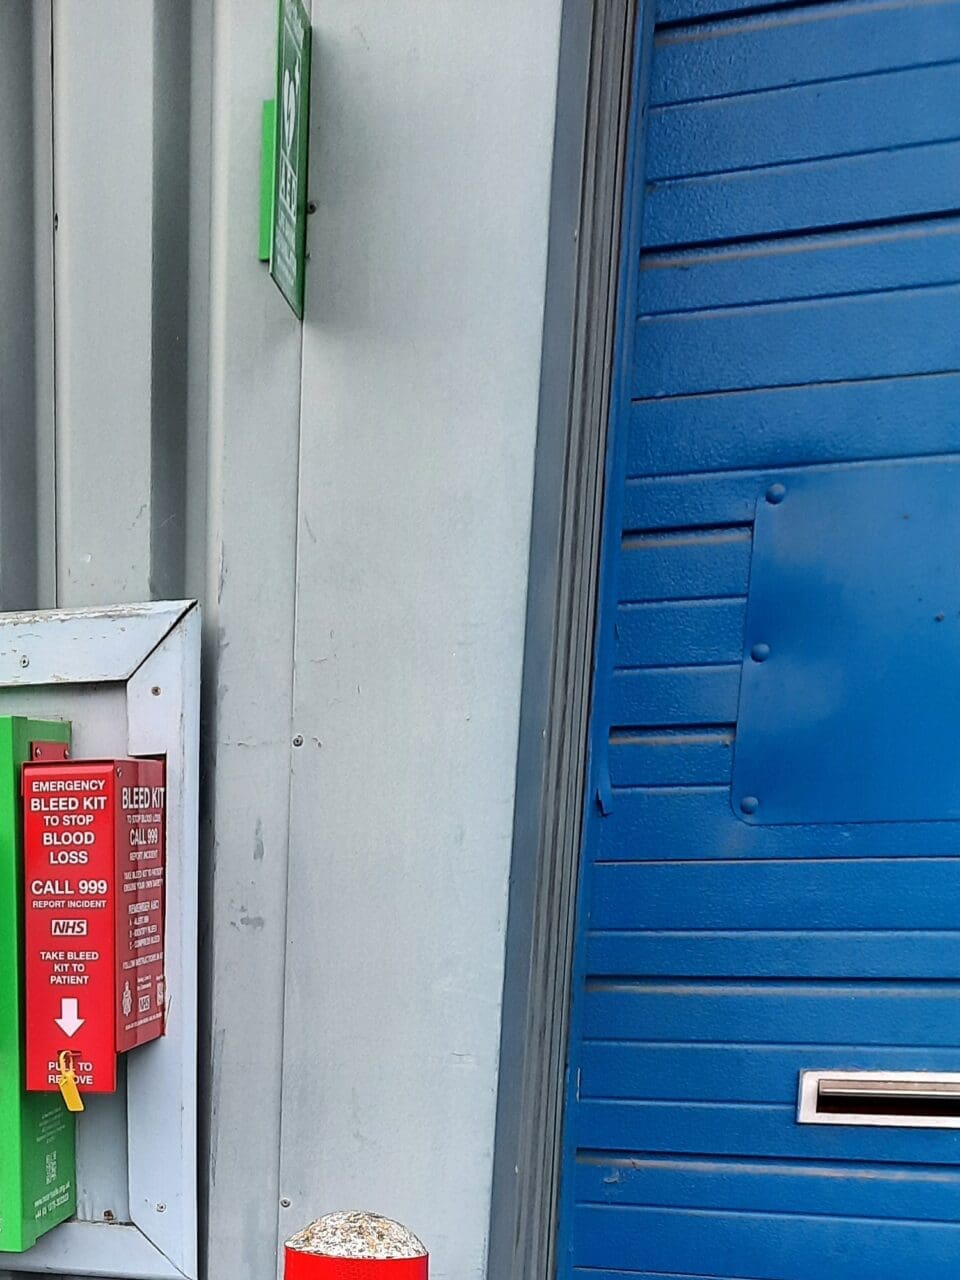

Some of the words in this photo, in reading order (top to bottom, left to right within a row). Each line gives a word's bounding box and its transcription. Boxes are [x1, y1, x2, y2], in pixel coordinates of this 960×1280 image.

[31, 779, 106, 792] EMERGENCY
[30, 797, 79, 811] BLEED
[82, 796, 108, 810] KIT
[122, 787, 150, 810] BLEED
[151, 786, 165, 809] KIT
[43, 815, 59, 826] TO
[62, 814, 94, 826] STOP
[42, 831, 95, 846] BLOOD
[129, 828, 146, 846] CALL
[147, 827, 158, 844] 999
[49, 851, 89, 864] LOSS
[31, 880, 75, 895] CALL
[78, 879, 108, 895] 999
[32, 899, 66, 909] REPORT
[67, 899, 107, 909] INCIDENT
[53, 920, 86, 935] NHS
[39, 951, 65, 961] TAKE
[67, 951, 100, 961] BLEED
[53, 963, 70, 973] KIT
[72, 963, 86, 973] TO
[49, 974, 90, 986] PATIENT
[77, 1062, 94, 1073] TO
[48, 1074, 94, 1086] REOVE
